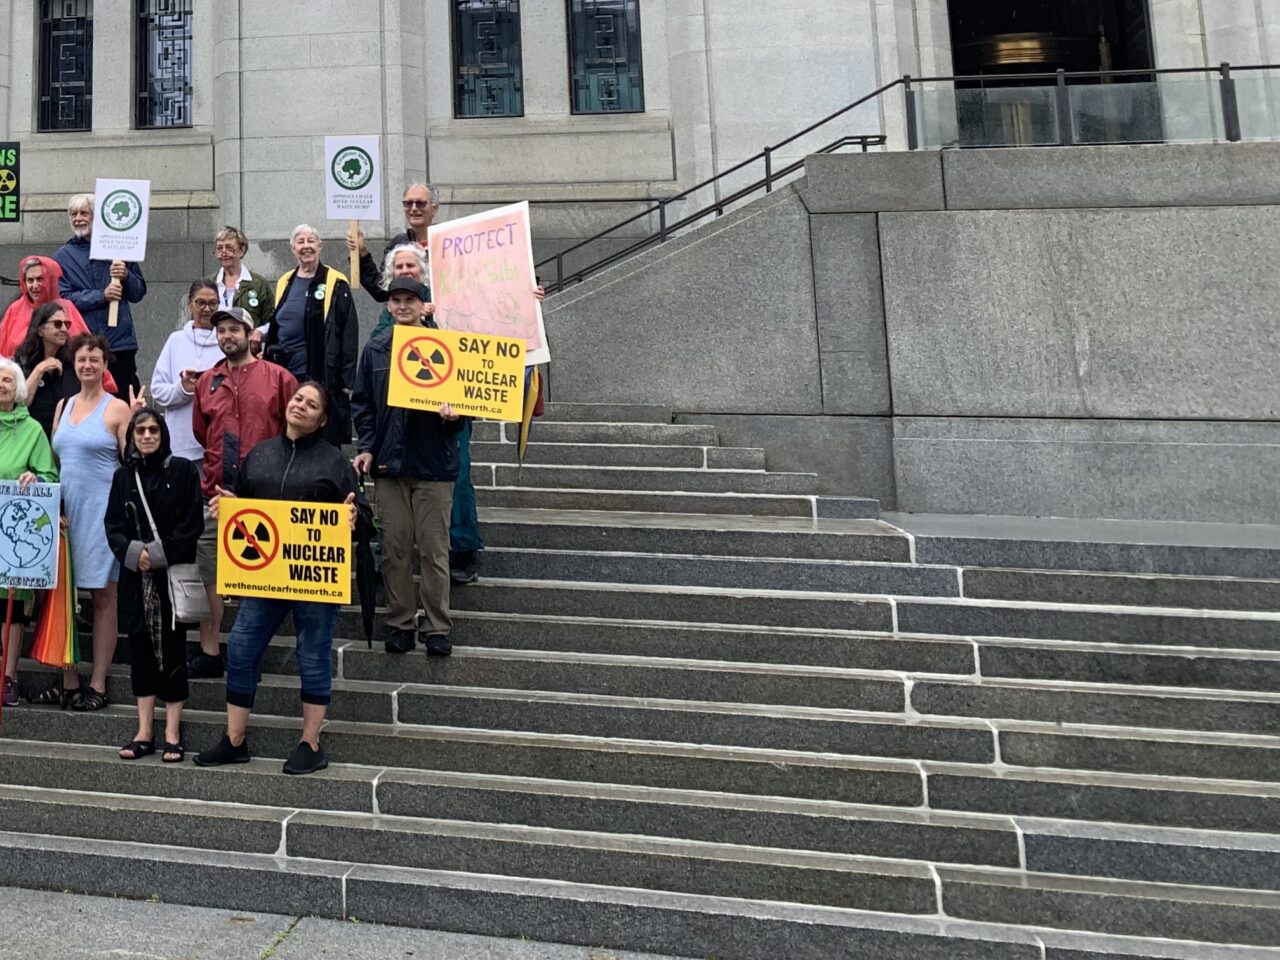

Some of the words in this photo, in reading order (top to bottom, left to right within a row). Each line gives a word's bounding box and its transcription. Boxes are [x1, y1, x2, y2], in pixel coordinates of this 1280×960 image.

[441, 222, 518, 259] PROTECT
[458, 336, 491, 355] SAY
[496, 341, 520, 359] NO
[481, 358, 495, 370] TO
[456, 368, 517, 388] NUCLEAR
[463, 385, 508, 403] WASTE
[290, 506, 316, 525] SAY
[320, 509, 339, 526] NO
[307, 528, 322, 543] TO
[282, 543, 345, 564] NUCLEAR
[289, 563, 339, 584] WASTE
[224, 581, 343, 598] wethenuclearfreenorth.ca
